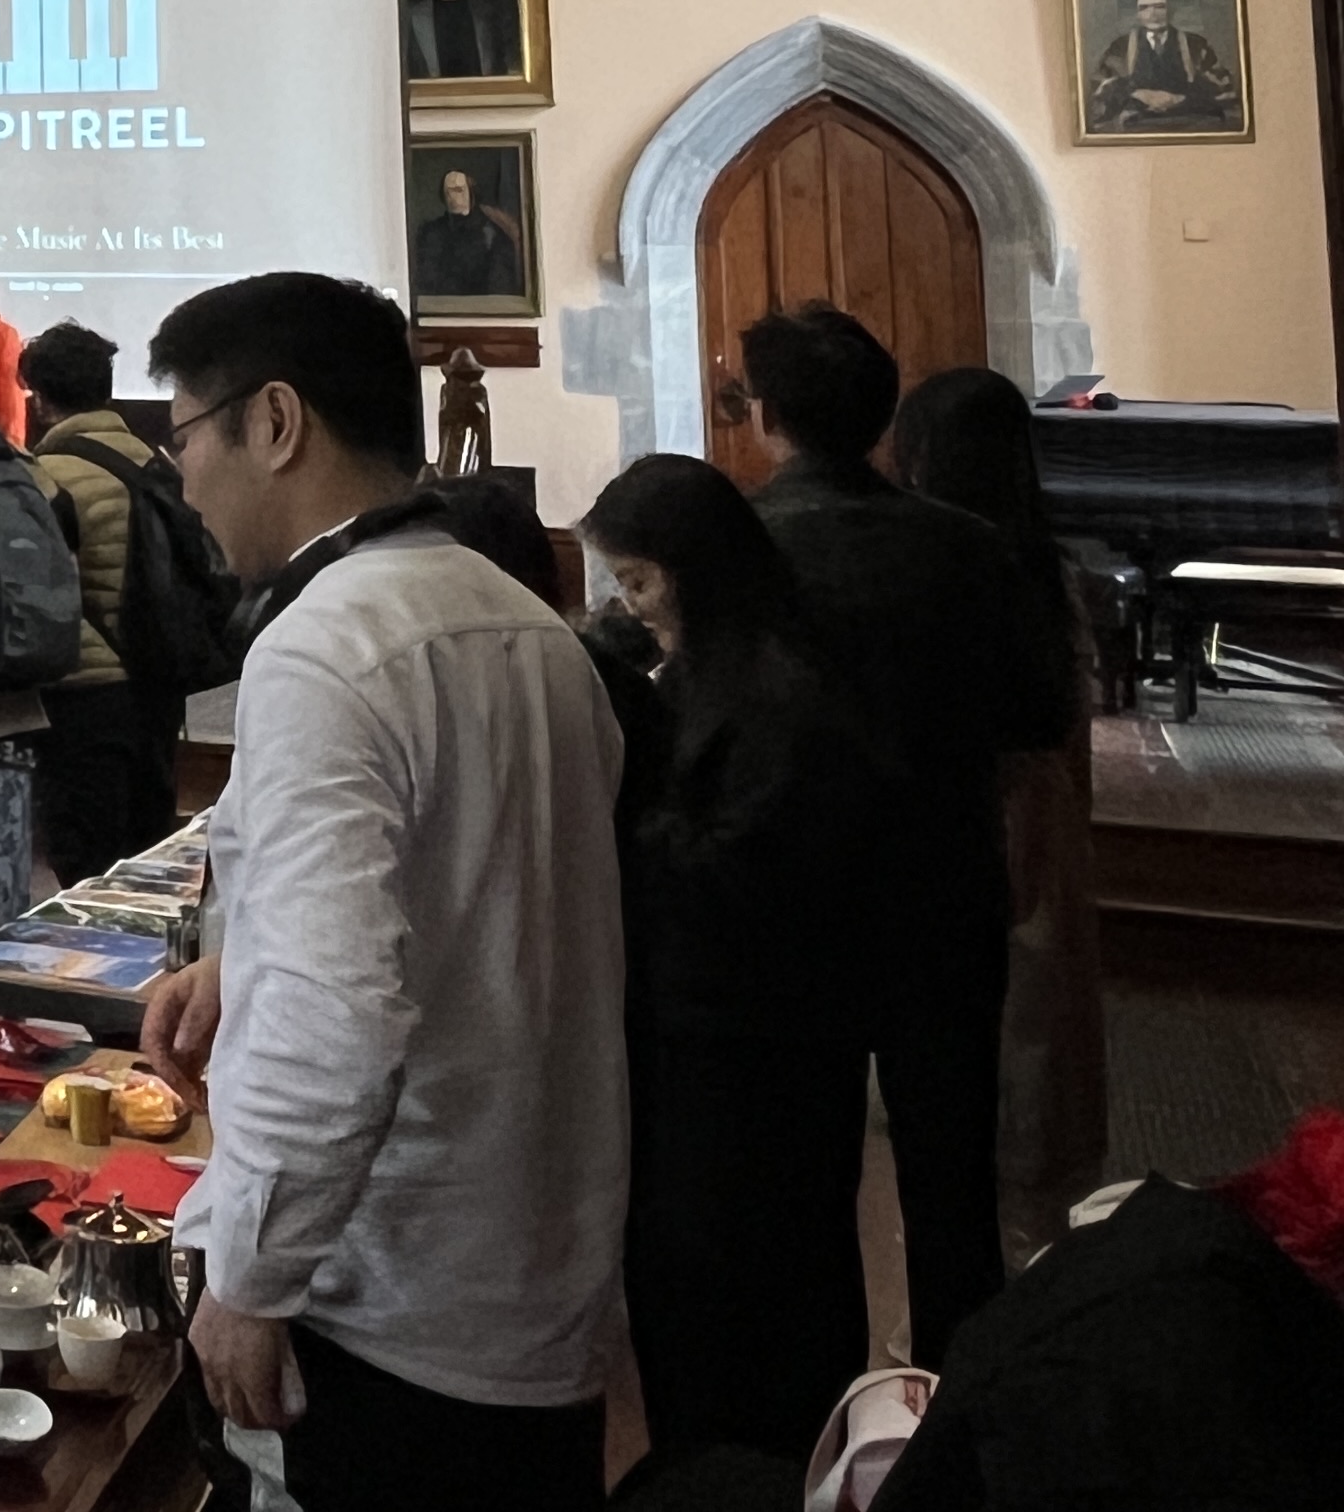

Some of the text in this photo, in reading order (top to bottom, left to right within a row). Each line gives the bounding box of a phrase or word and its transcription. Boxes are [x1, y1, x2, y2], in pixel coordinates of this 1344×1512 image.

[15, 224, 88, 251] Music
[95, 226, 125, 251] At
[171, 225, 225, 251] Best
